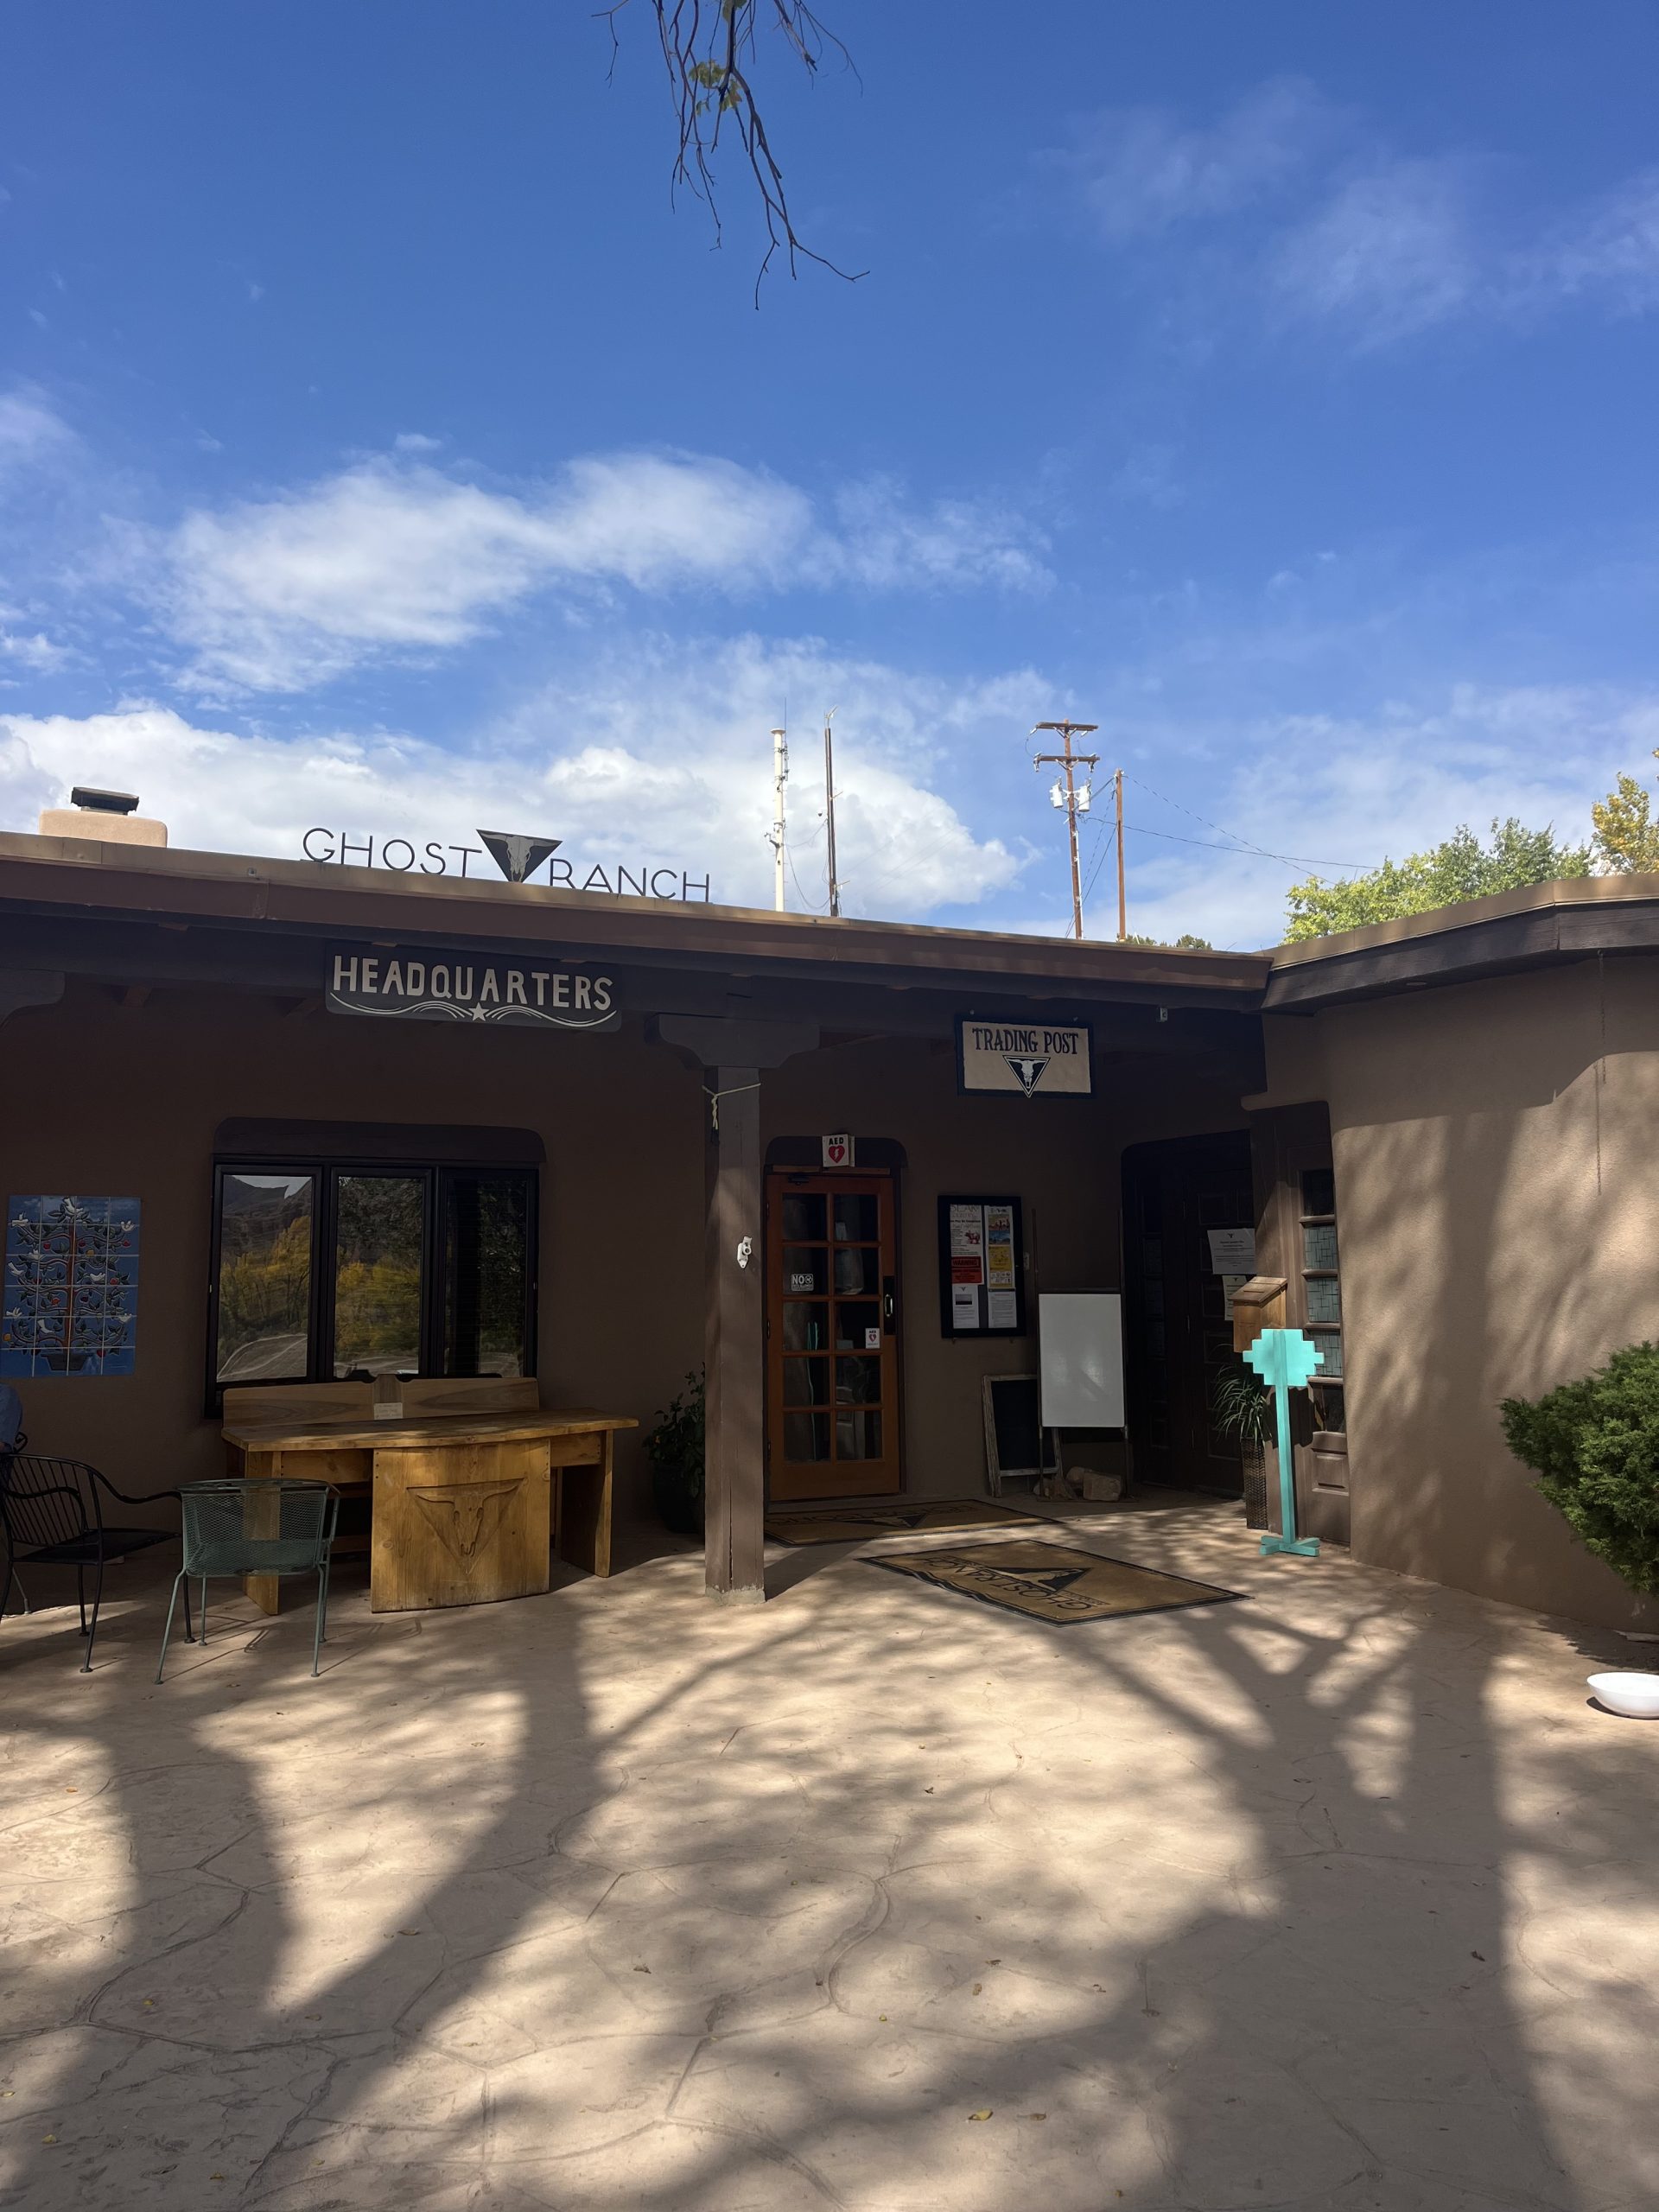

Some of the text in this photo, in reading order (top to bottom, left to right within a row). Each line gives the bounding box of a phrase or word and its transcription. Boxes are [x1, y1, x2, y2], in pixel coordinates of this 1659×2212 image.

[302, 827, 710, 903] GHOST RANCH
[333, 955, 613, 1011] HEADQUARTERS
[972, 1027, 1079, 1055] TRADING POST
[829, 1137, 844, 1146] AED
[913, 1557, 1003, 1582] RANCH
[991, 1580, 1092, 1610] GHOST
